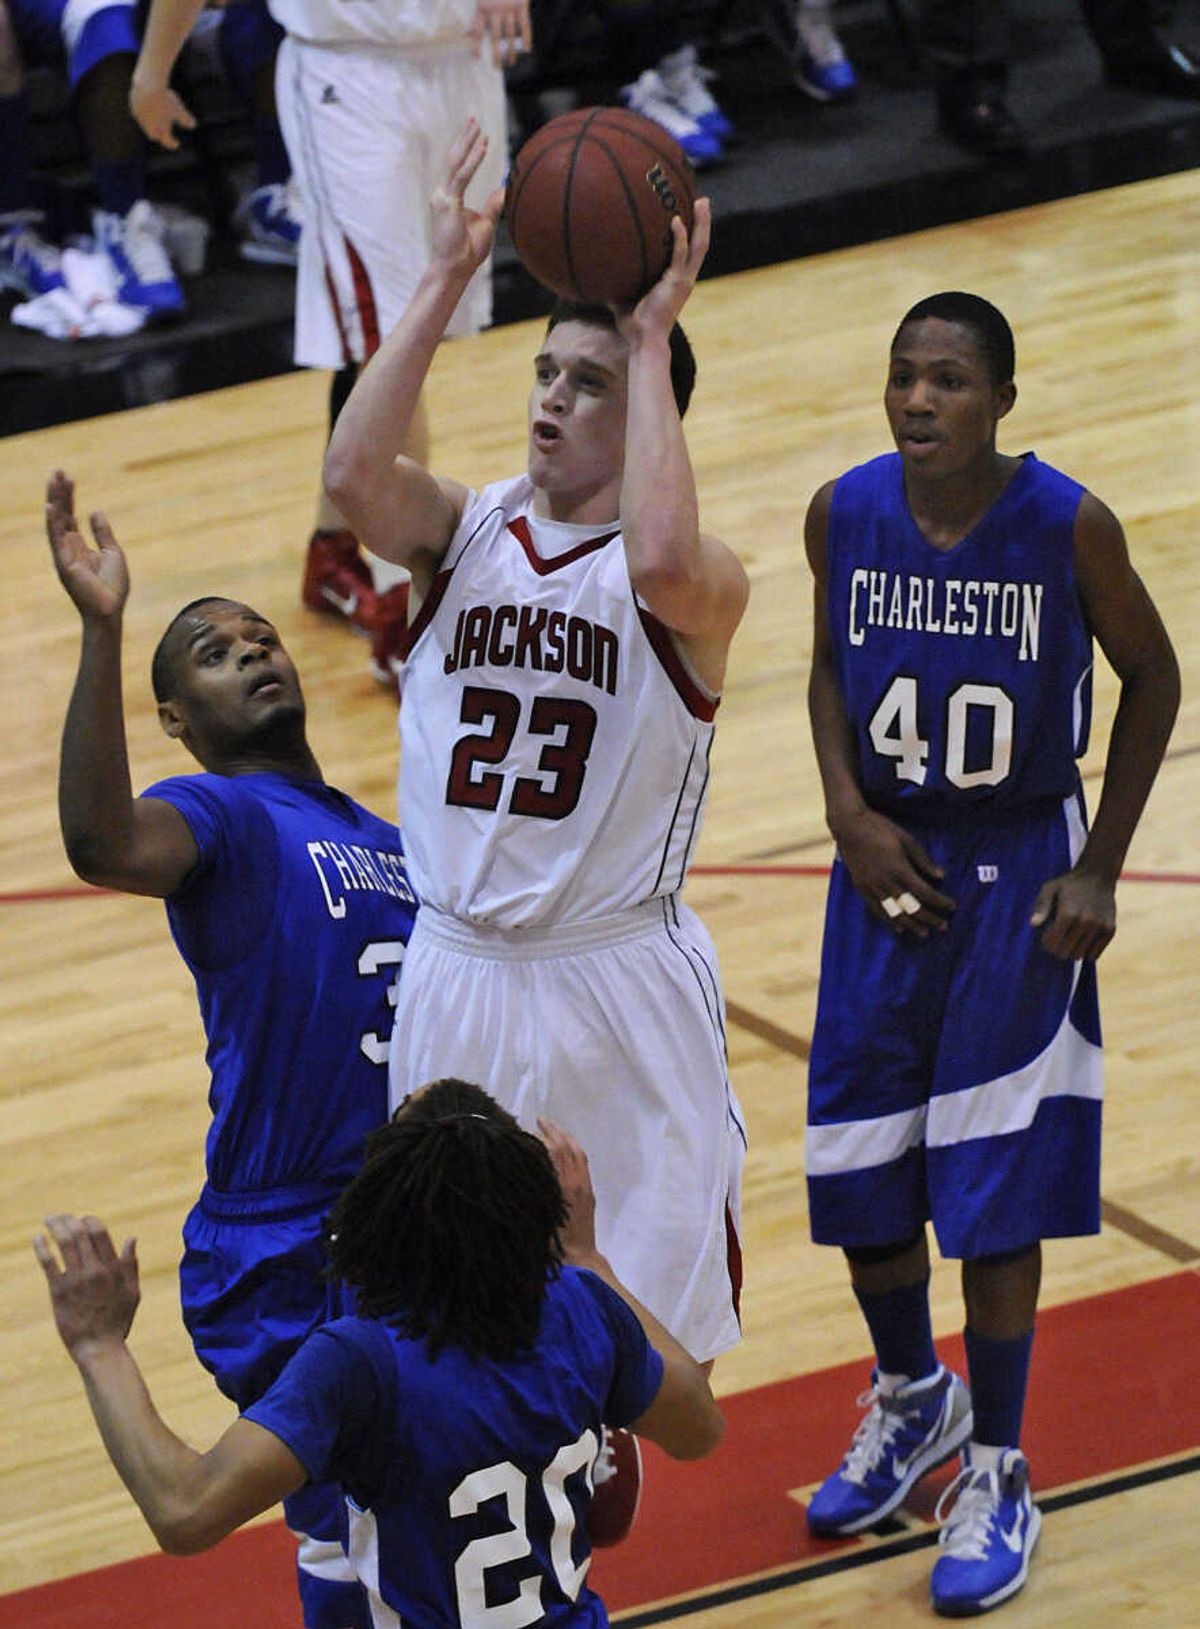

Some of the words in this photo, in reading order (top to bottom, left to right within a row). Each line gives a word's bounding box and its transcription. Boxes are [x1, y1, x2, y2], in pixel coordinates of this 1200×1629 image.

[443, 605, 619, 697] JACKSON
[849, 568, 1044, 662] CHARLESTON
[445, 685, 598, 821] 23
[868, 676, 1014, 790] 40
[306, 841, 416, 919] CHARLES
